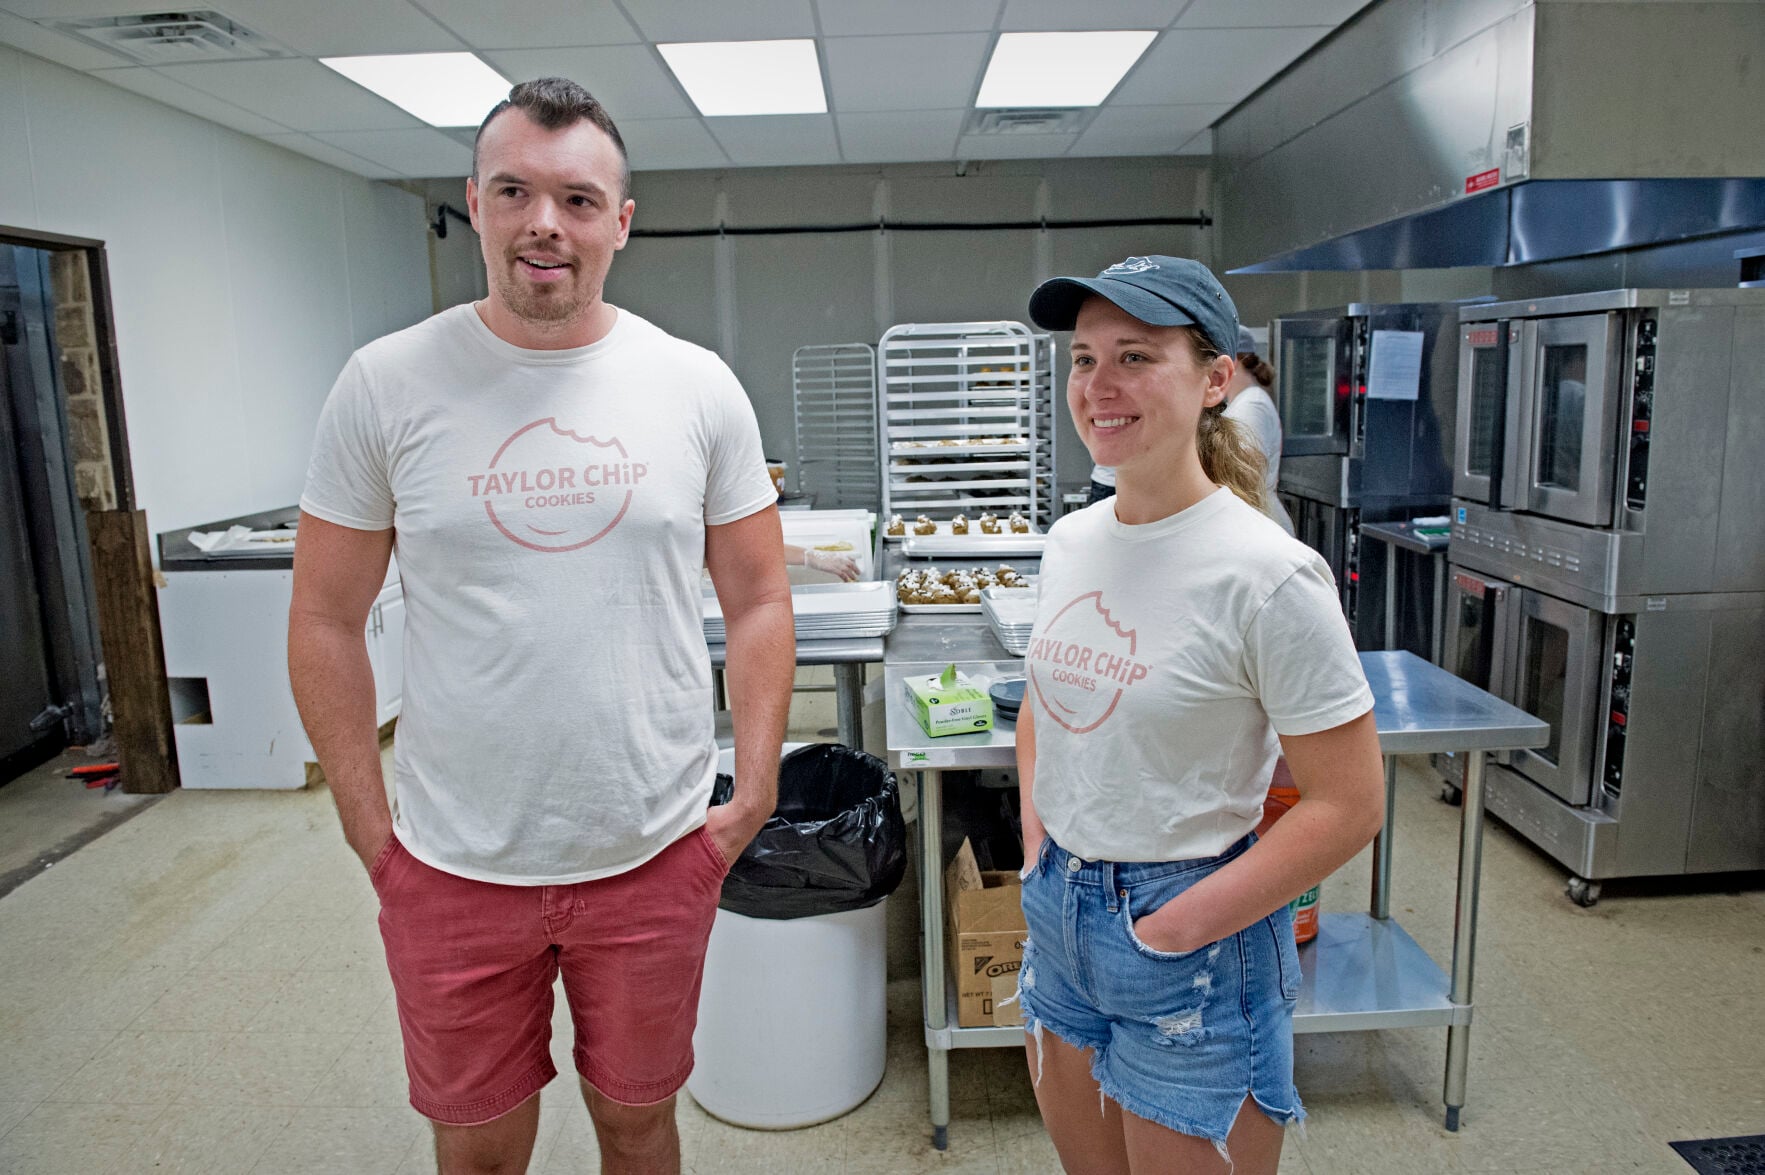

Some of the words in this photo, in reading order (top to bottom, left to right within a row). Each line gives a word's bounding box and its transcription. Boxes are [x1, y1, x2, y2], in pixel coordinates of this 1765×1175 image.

[467, 467, 576, 497] TAYLOR
[524, 492, 596, 509] COOKIES
[1052, 668, 1097, 692] COOKIES
